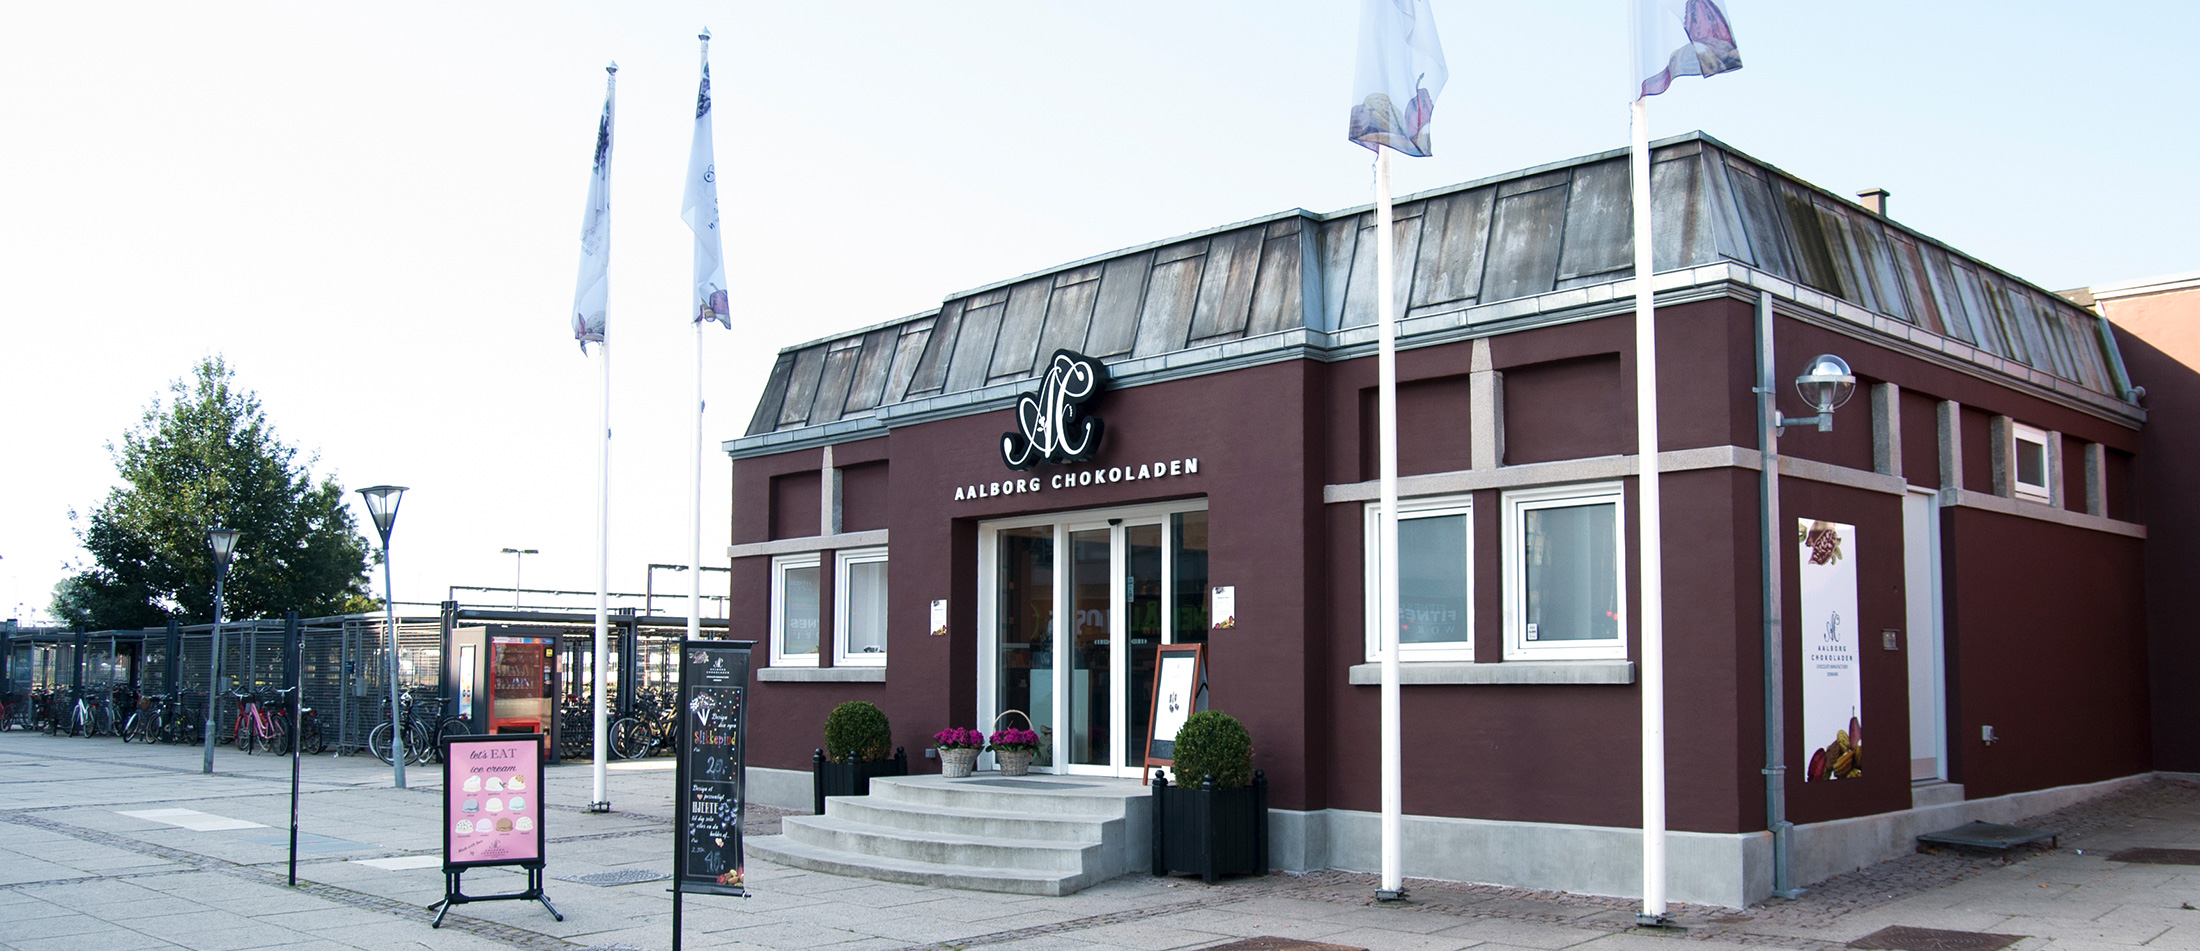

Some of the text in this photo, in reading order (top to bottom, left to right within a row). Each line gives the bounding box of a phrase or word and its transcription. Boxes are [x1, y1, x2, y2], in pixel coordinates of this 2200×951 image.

[954, 458, 1199, 501] AALBORG CHOKOLADEN
[1811, 654, 1853, 662] CHOKOLADEN
[694, 730, 736, 748] Slikkepind
[469, 748, 517, 760] let's EAT
[486, 765, 517, 773] cream
